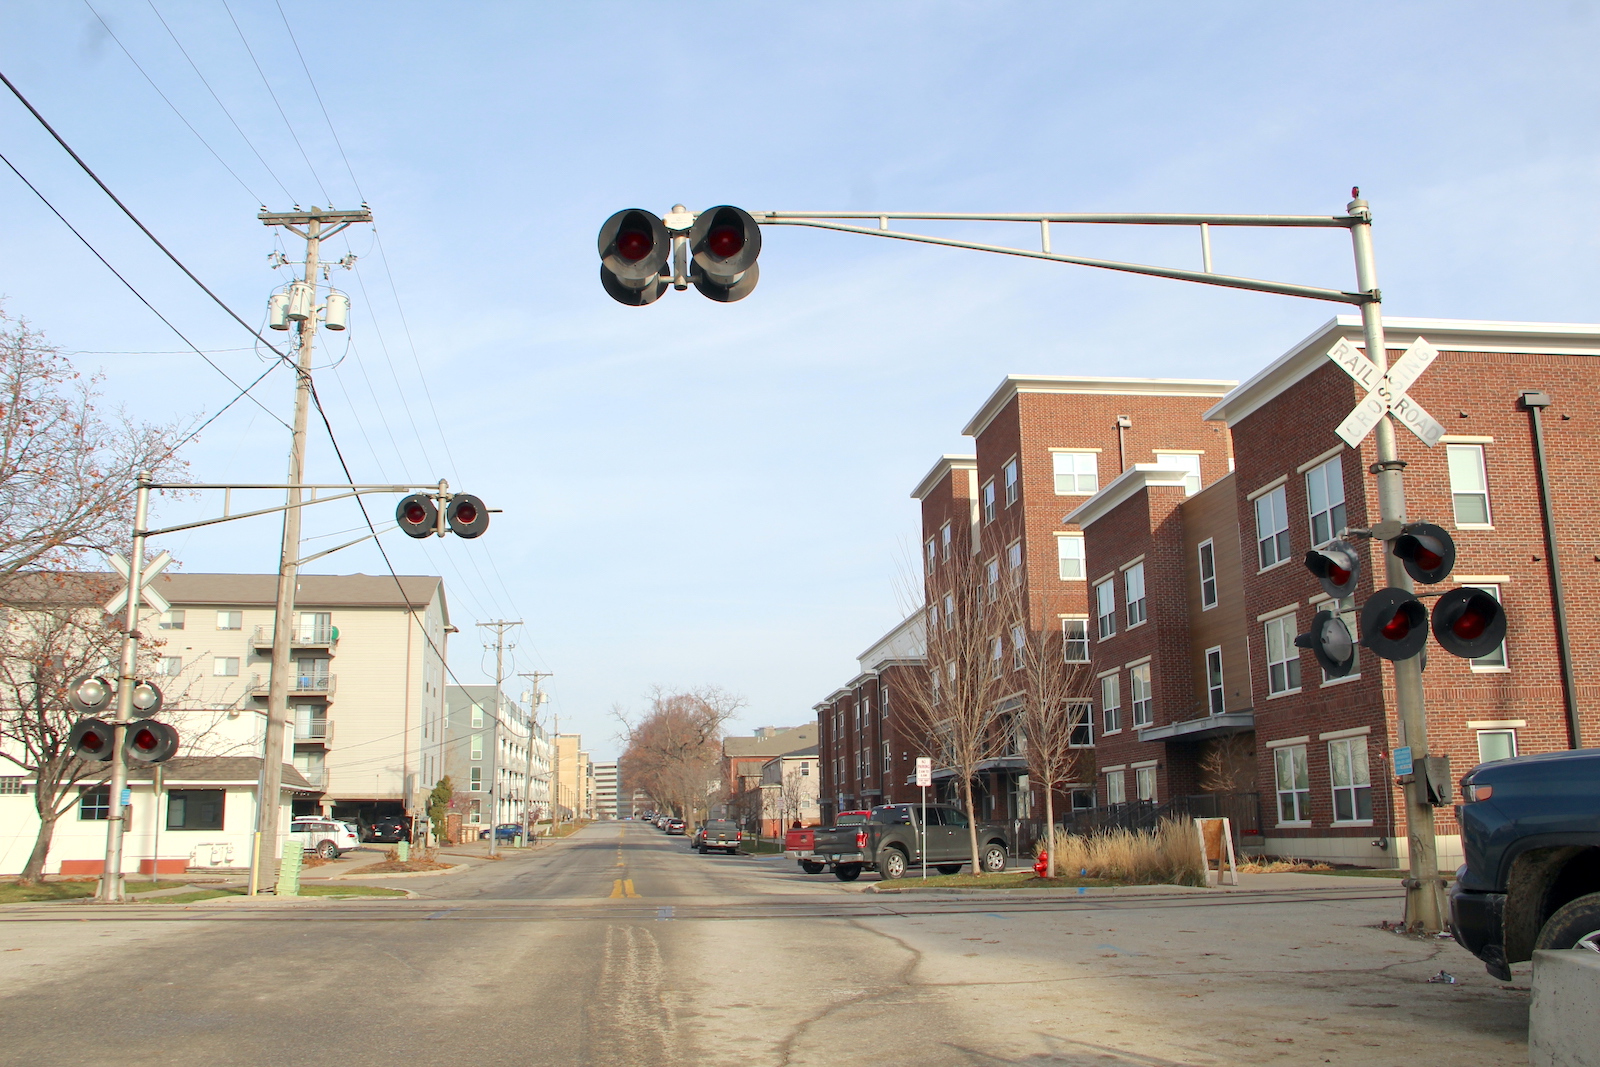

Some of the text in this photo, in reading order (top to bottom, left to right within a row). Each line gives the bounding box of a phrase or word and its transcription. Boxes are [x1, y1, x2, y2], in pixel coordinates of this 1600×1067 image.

[1333, 343, 1440, 441] RAIL ROAD
[1346, 347, 1429, 438] CROSSING
